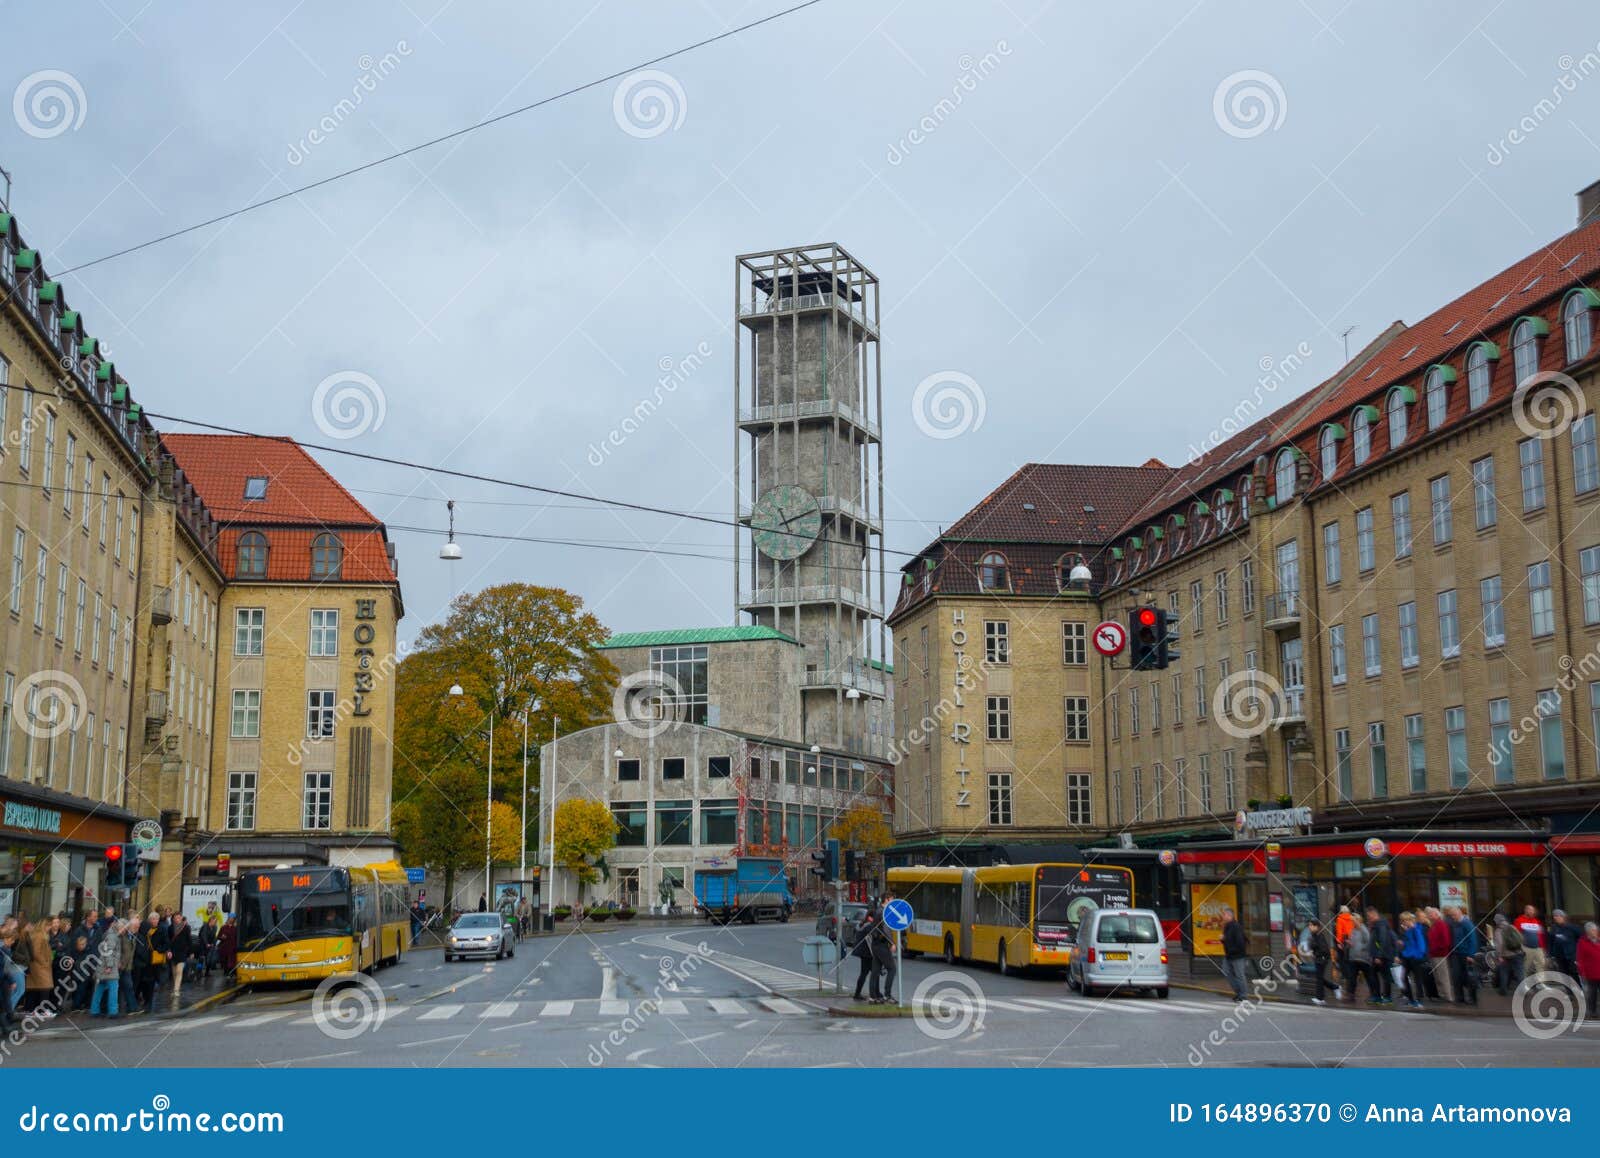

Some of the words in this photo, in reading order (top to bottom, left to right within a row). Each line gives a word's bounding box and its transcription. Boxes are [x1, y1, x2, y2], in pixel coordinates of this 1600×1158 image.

[353, 599, 377, 717] HOTEL
[951, 609, 967, 707] HOTEL
[951, 722, 971, 807] RITZ
[1424, 844, 1460, 853] TASTE
[1463, 844, 1474, 853] IS
[1477, 844, 1506, 853] KING
